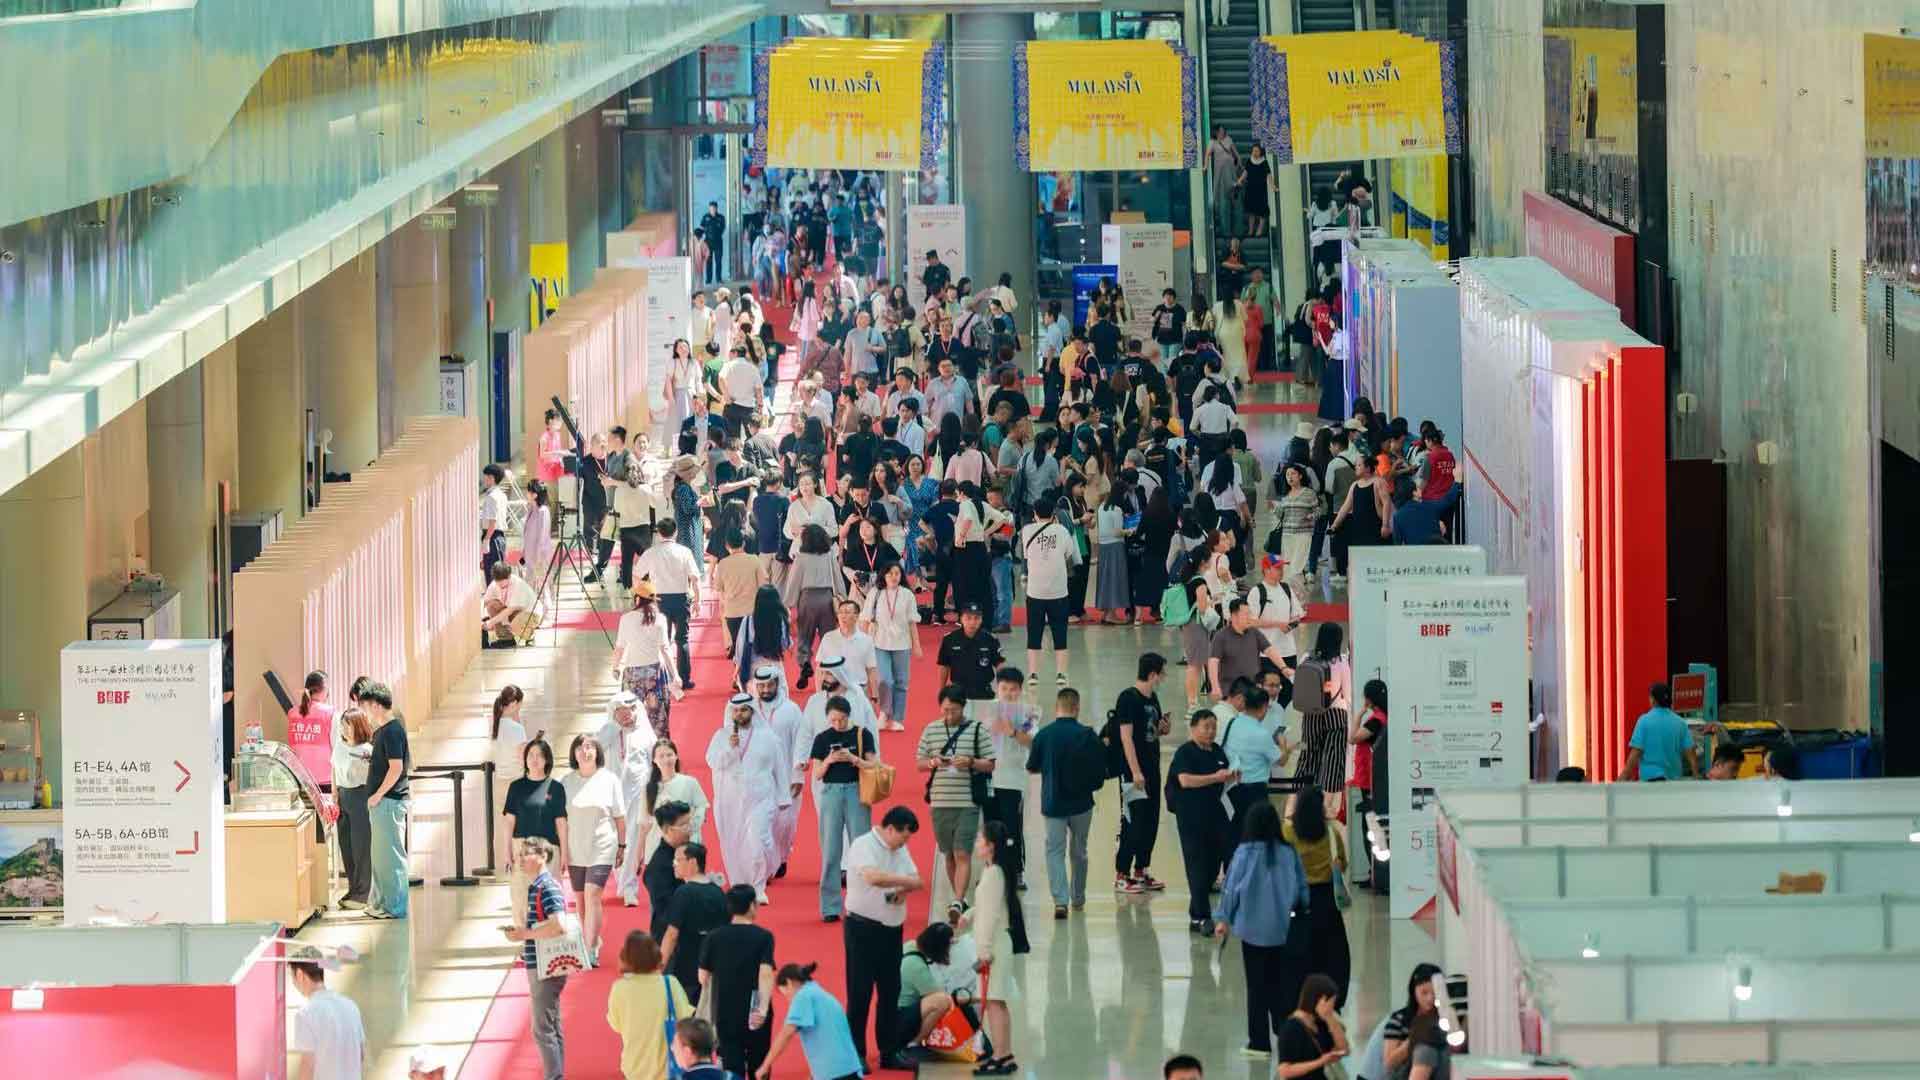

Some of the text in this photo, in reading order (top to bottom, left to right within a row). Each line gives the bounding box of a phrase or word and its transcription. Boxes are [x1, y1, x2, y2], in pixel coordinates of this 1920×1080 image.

[808, 76, 881, 93] MALAYSIA
[1327, 68, 1401, 86] MALAYSIA
[1067, 79, 1142, 94] MALAYSIA
[1420, 623, 1452, 637] BIBF
[96, 690, 131, 705] BIBF
[1410, 704, 1418, 724] 1
[1489, 730, 1503, 752] 2
[1409, 758, 1423, 780] 3
[1410, 830, 1423, 850] 5
